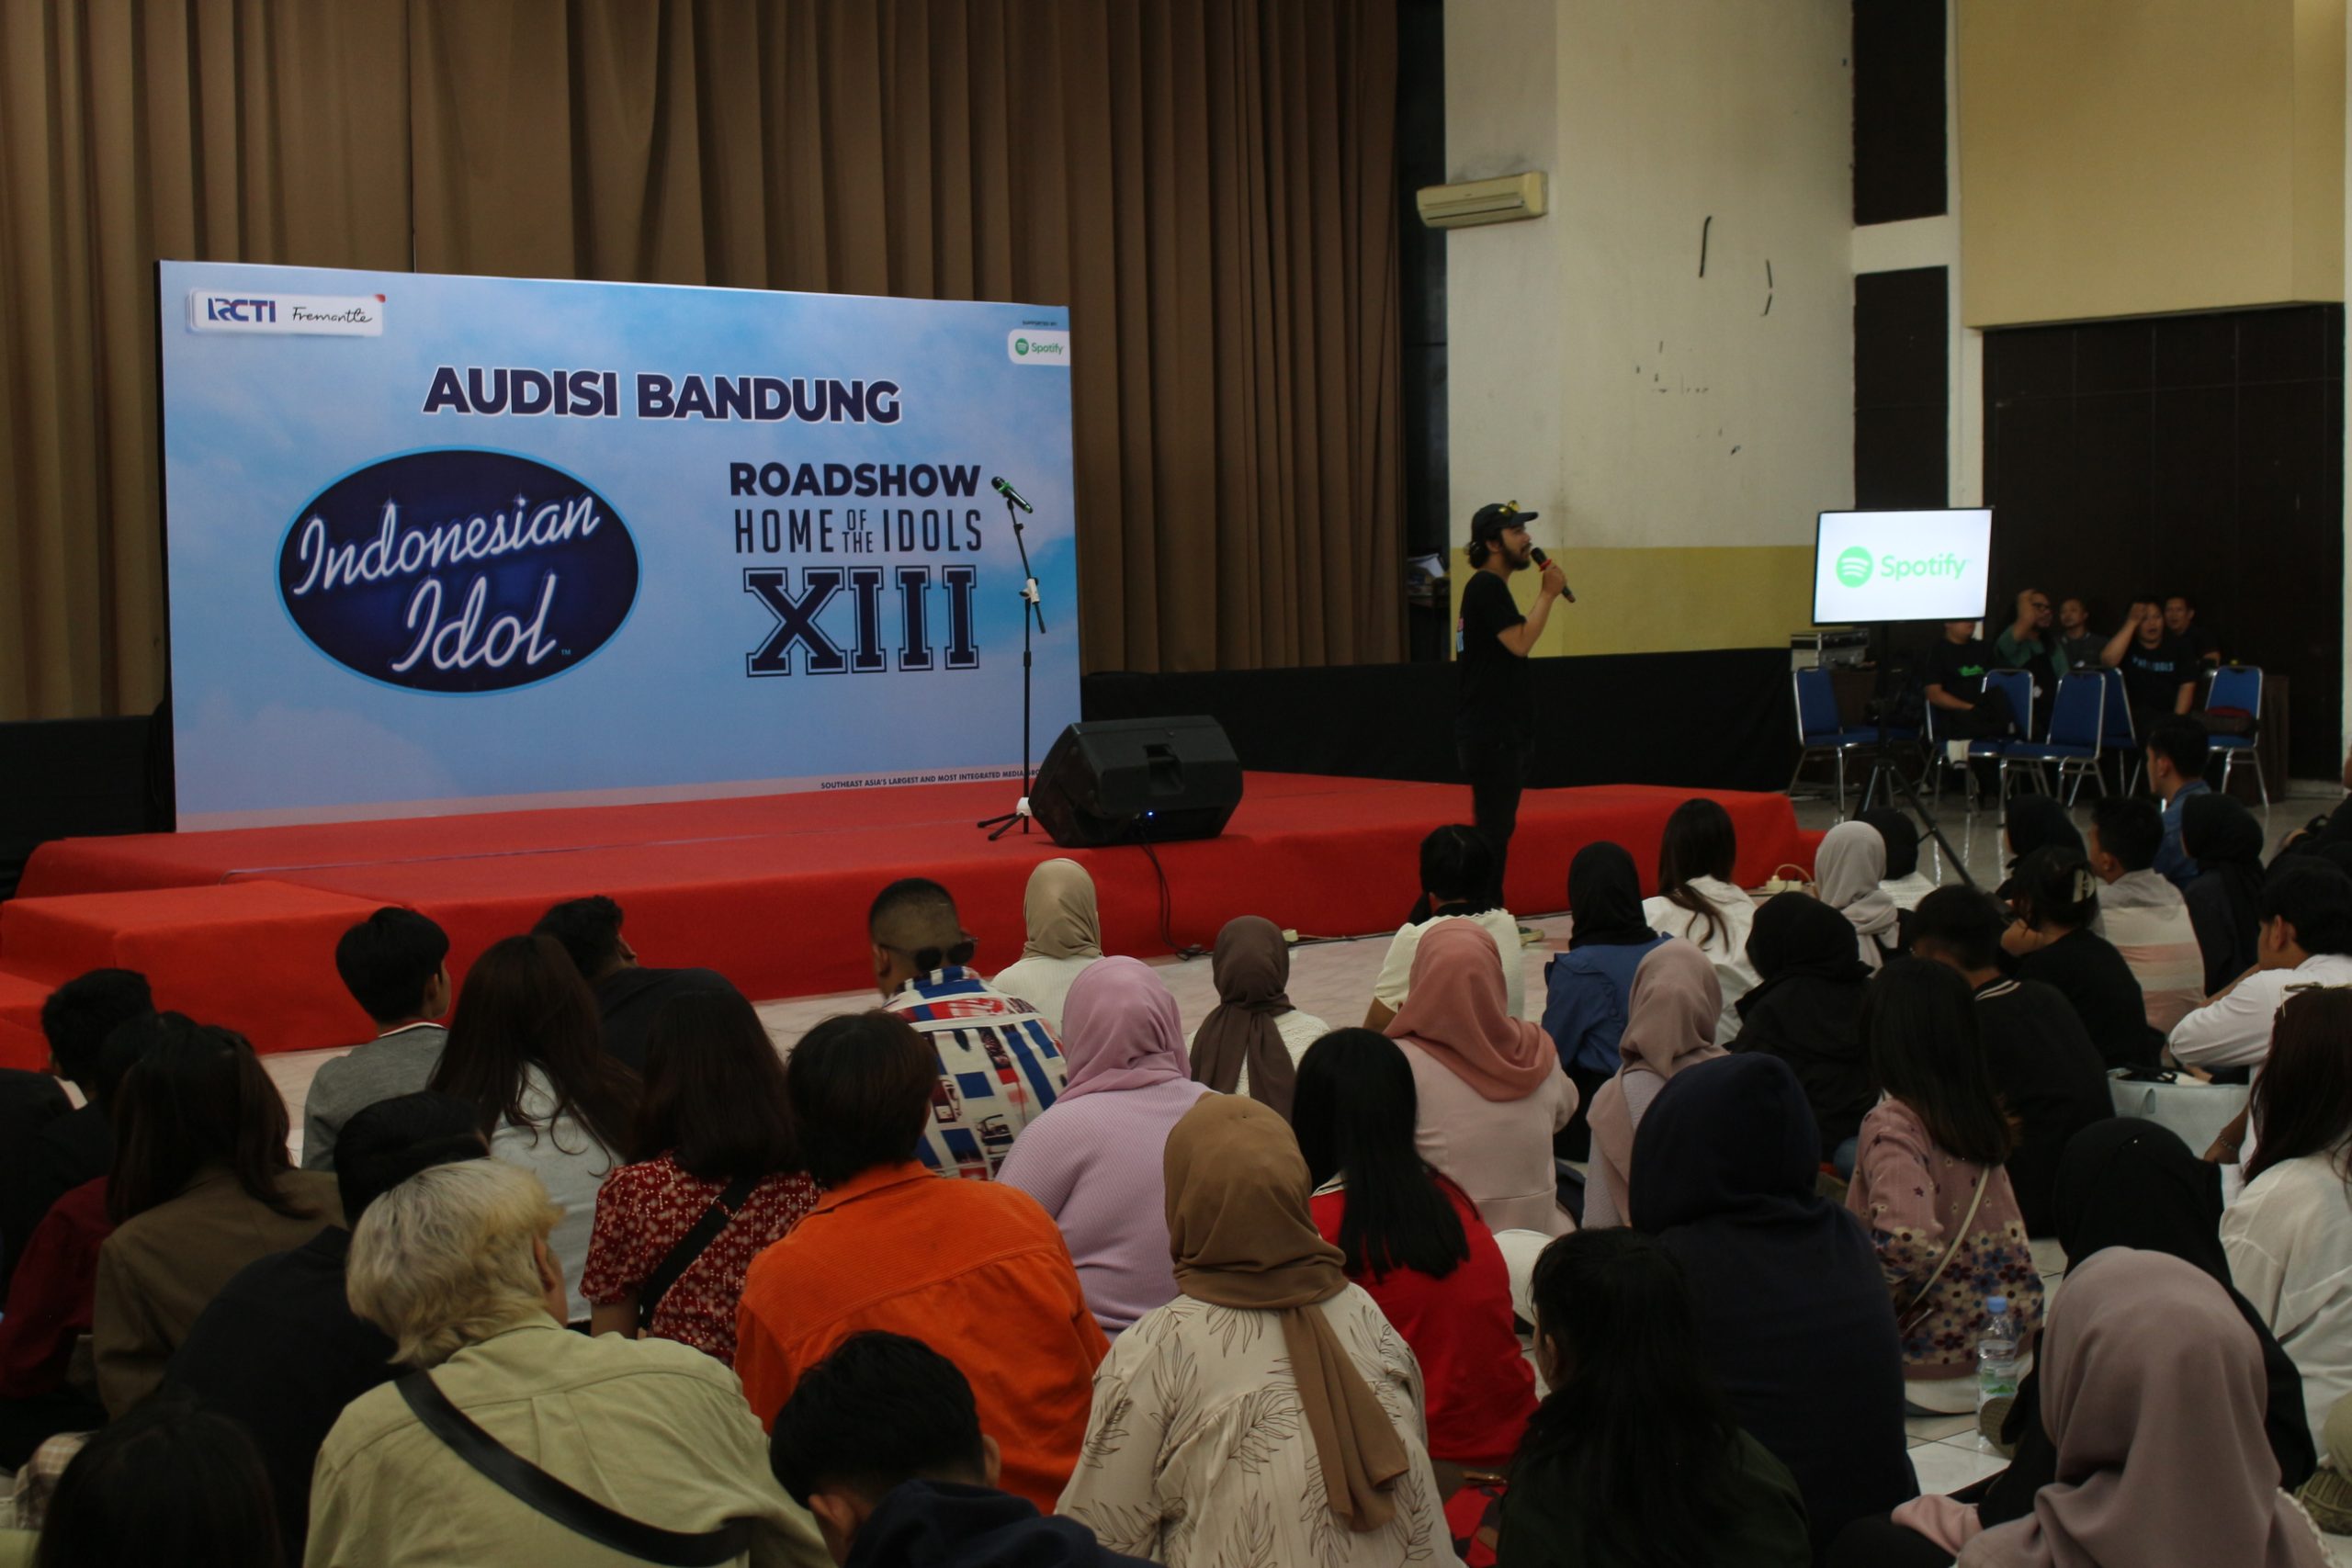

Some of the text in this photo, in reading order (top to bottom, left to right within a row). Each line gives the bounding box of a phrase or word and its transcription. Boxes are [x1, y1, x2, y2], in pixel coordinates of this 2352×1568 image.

[208, 298, 276, 322] RCTI
[292, 307, 372, 323] Fremantle
[1031, 343, 1063, 355] Spotify
[423, 366, 901, 424] AUDISI BANDUNG
[730, 462, 981, 497] ROADSHOW
[293, 496, 600, 594] Indonesian
[735, 509, 982, 553] HOME OF THE IDOLS
[1881, 553, 1966, 581] Spotify
[391, 573, 557, 671] Idol
[743, 564, 979, 678] XIII
[820, 780, 863, 789] SOUTHEAST
[865, 778, 887, 786] ASIA'S
[888, 776, 919, 784] LARGEST
[920, 774, 936, 783] AND
[938, 773, 957, 782] MOST
[959, 771, 1001, 780] INTEGRATED
